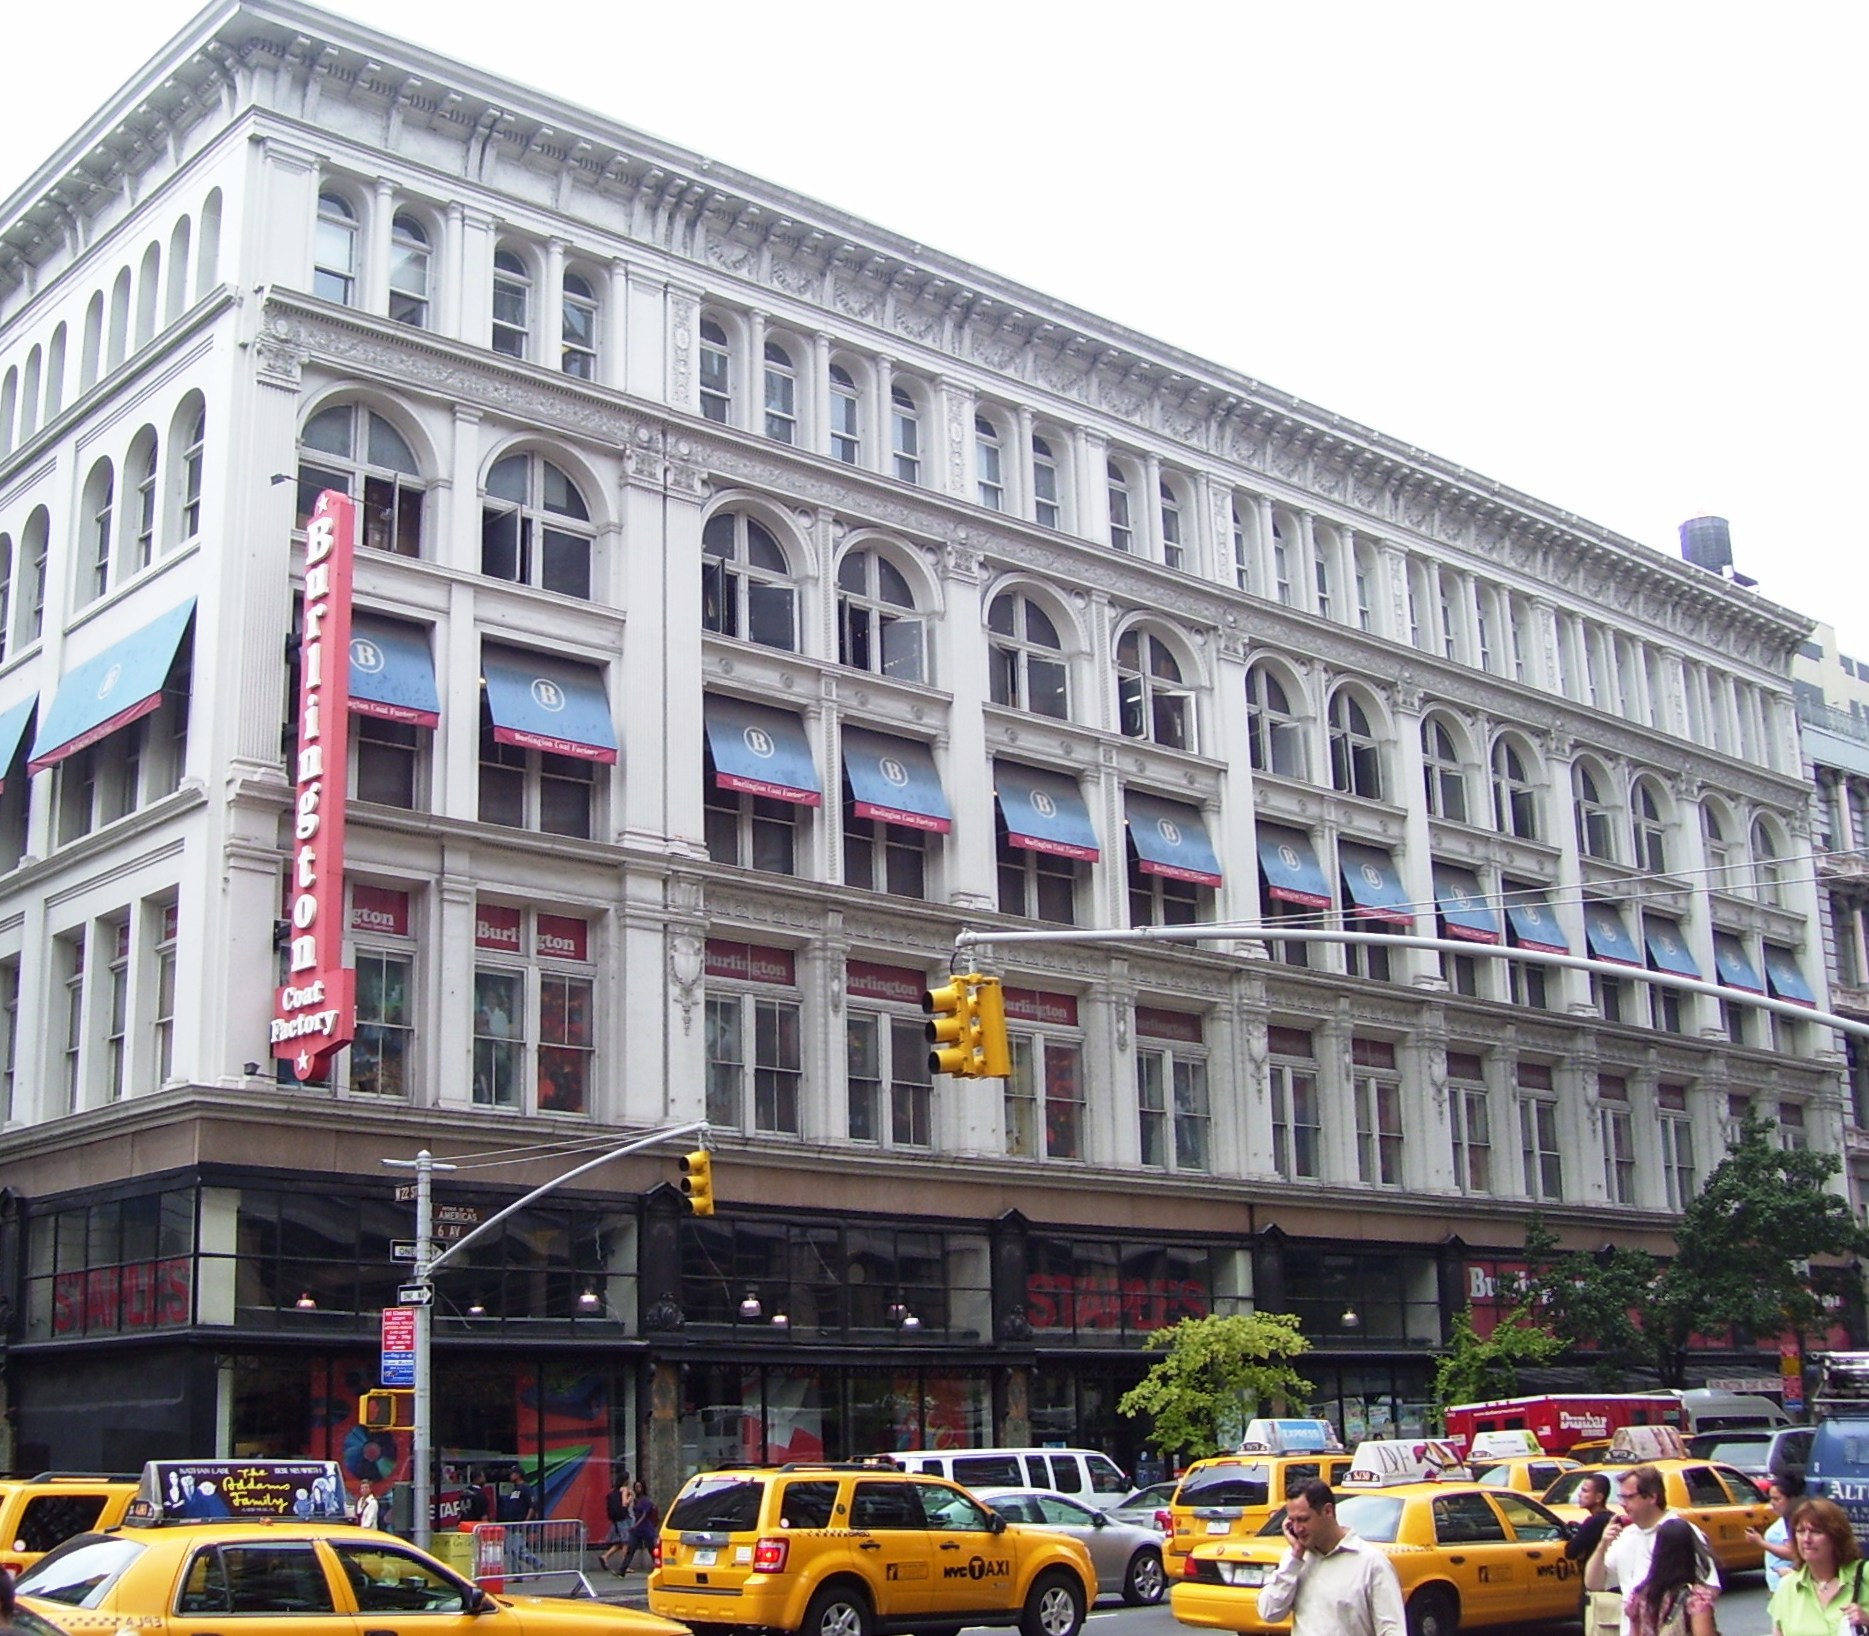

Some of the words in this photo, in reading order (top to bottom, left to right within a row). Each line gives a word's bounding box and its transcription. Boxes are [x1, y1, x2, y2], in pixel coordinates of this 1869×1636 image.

[355, 643, 376, 667] B
[537, 683, 557, 706] B
[291, 516, 334, 972] Burlington
[751, 732, 767, 753] B
[887, 762, 902, 781] B
[1034, 794, 1050, 814] B
[1162, 823, 1177, 842] B
[282, 980, 325, 1012] Coat
[847, 975, 918, 997] urlington
[1006, 1000, 1067, 1018] urlington
[271, 1009, 339, 1044] Factory
[439, 1210, 478, 1221] AMERICAS
[437, 1225, 444, 1237] 6
[449, 1226, 461, 1238] AV
[1560, 1411, 1607, 1430] Dunbar
[237, 1467, 269, 1479] The
[222, 1476, 291, 1491] Addams
[1828, 1480, 1869, 1500] ALT
[229, 1491, 289, 1514] Family
[944, 1565, 968, 1579] NYC
[970, 1557, 1010, 1580] TAXI
